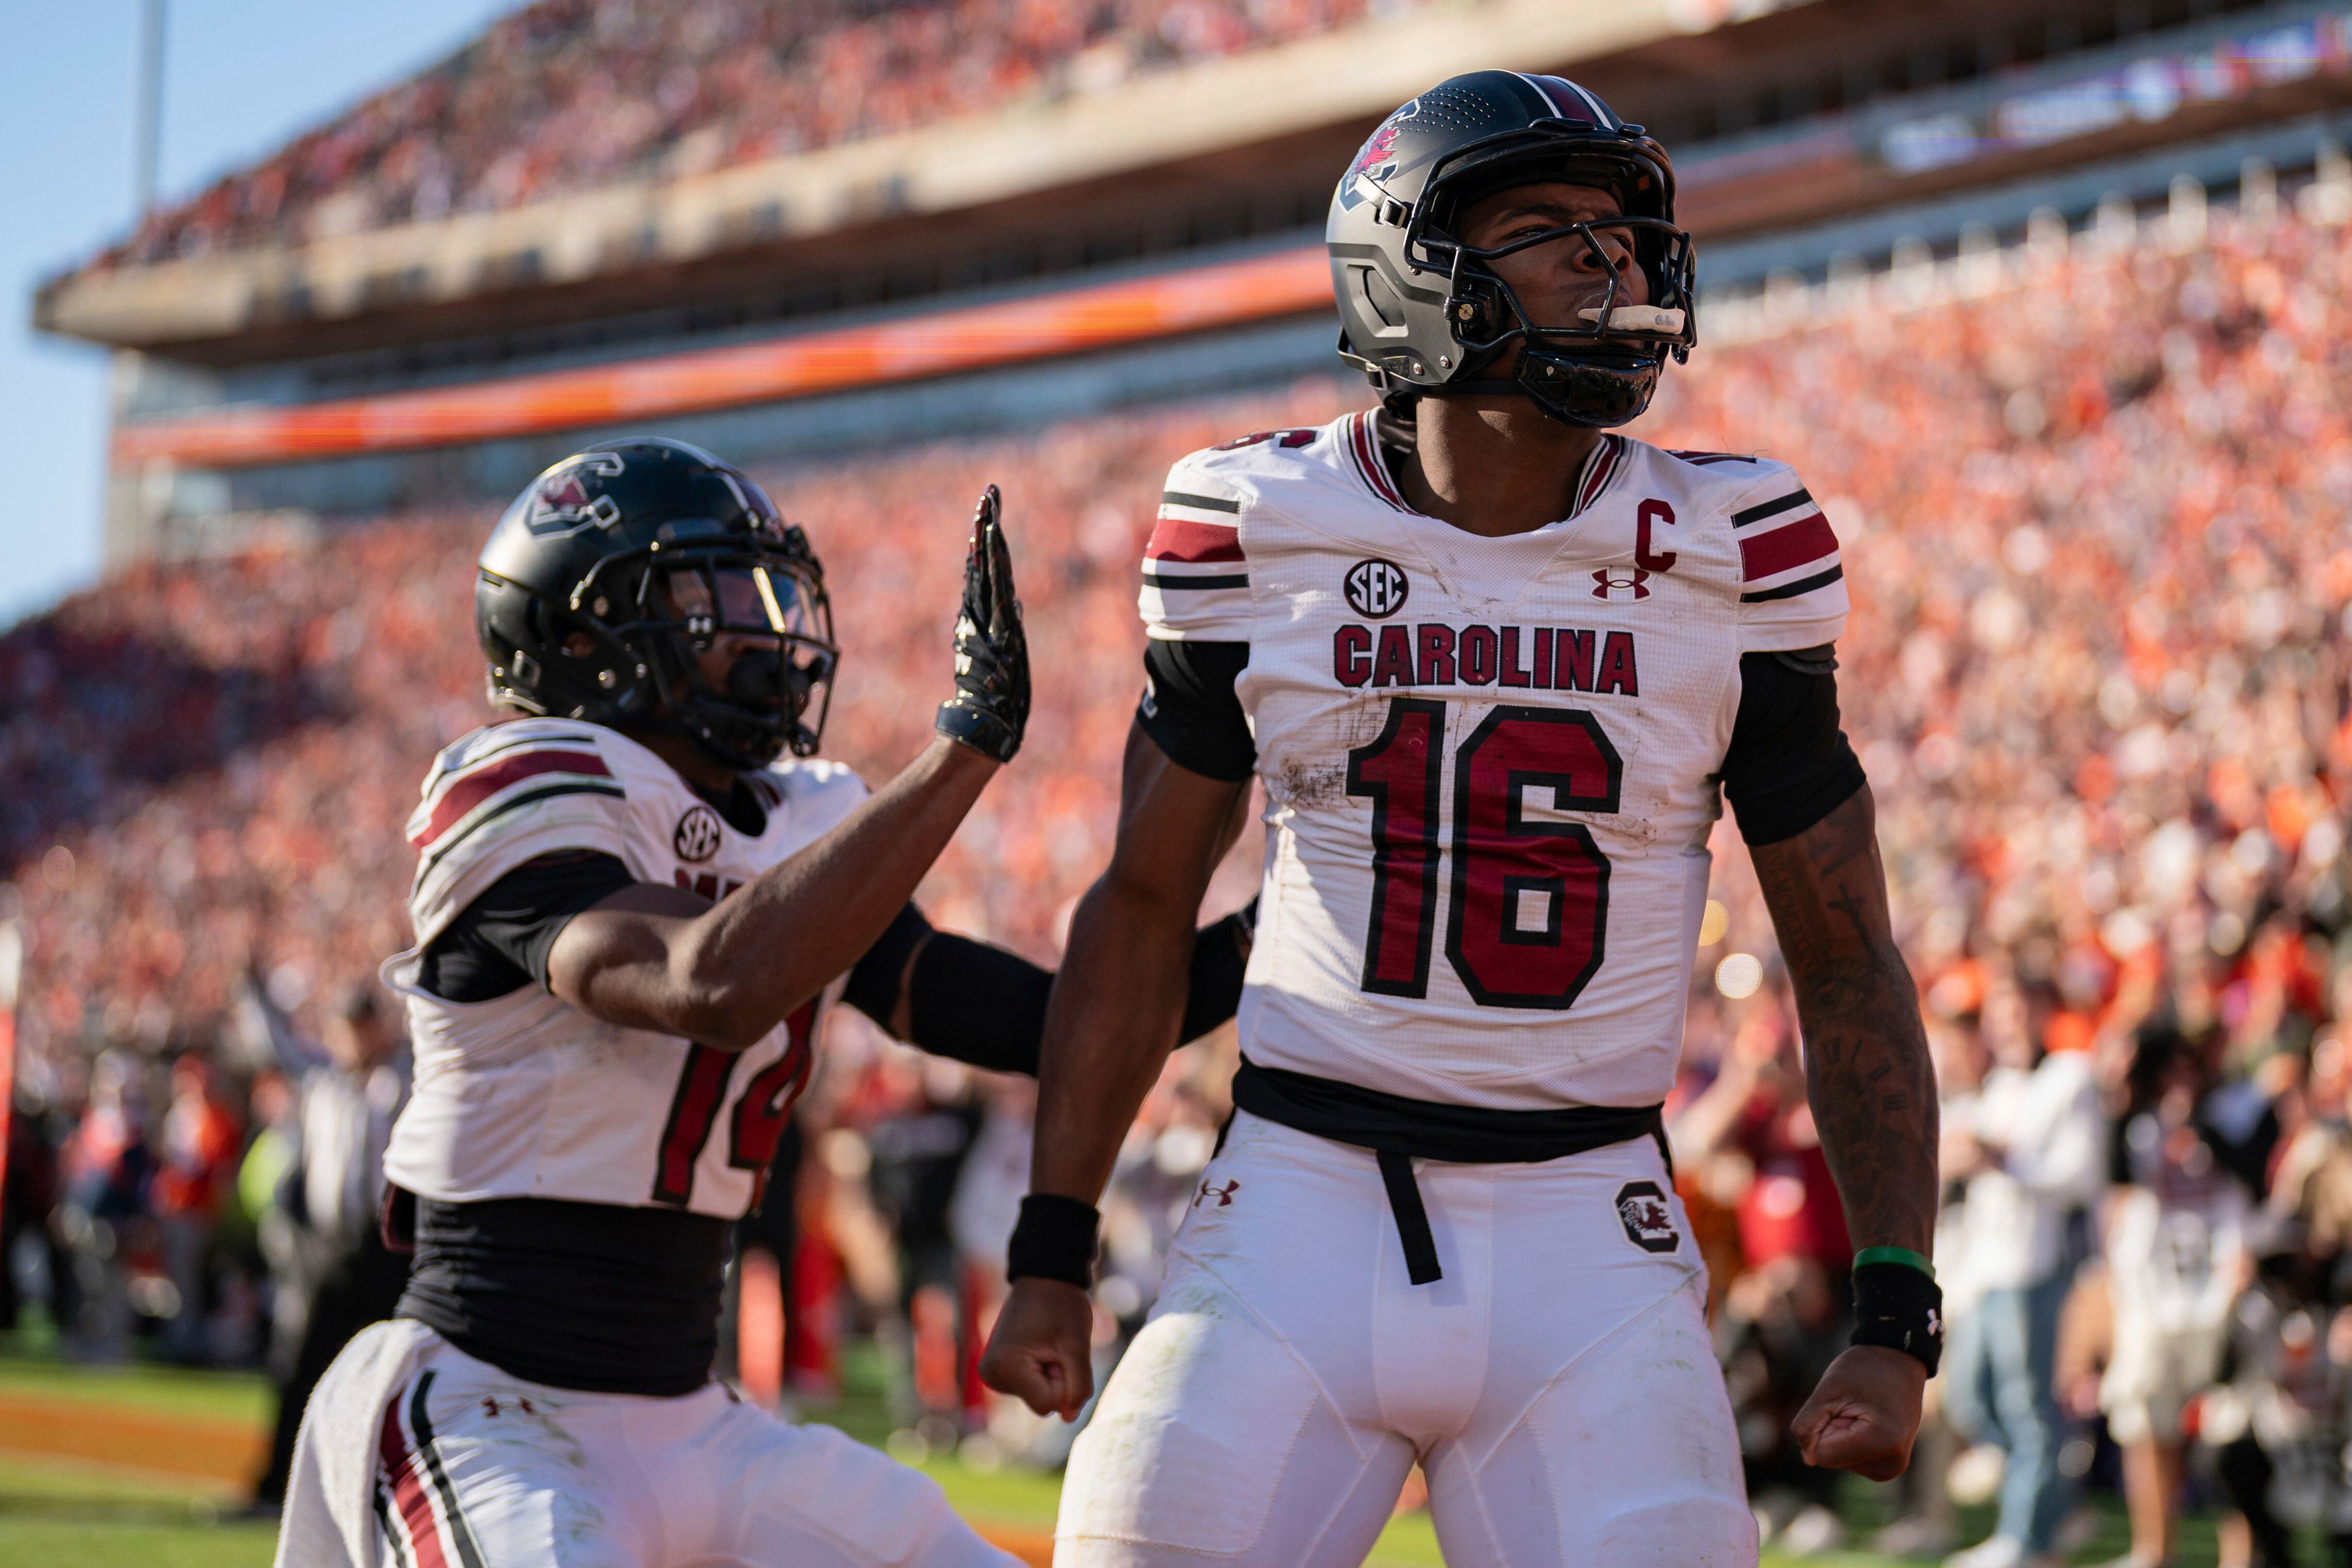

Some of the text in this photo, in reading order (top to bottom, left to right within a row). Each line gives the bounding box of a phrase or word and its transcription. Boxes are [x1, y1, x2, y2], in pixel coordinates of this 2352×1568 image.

[1635, 498, 1677, 572] C
[1350, 562, 1402, 614] SEC
[1334, 623, 1639, 697] CAROLINA
[677, 808, 718, 859] SEC
[1345, 697, 1624, 1010] 16
